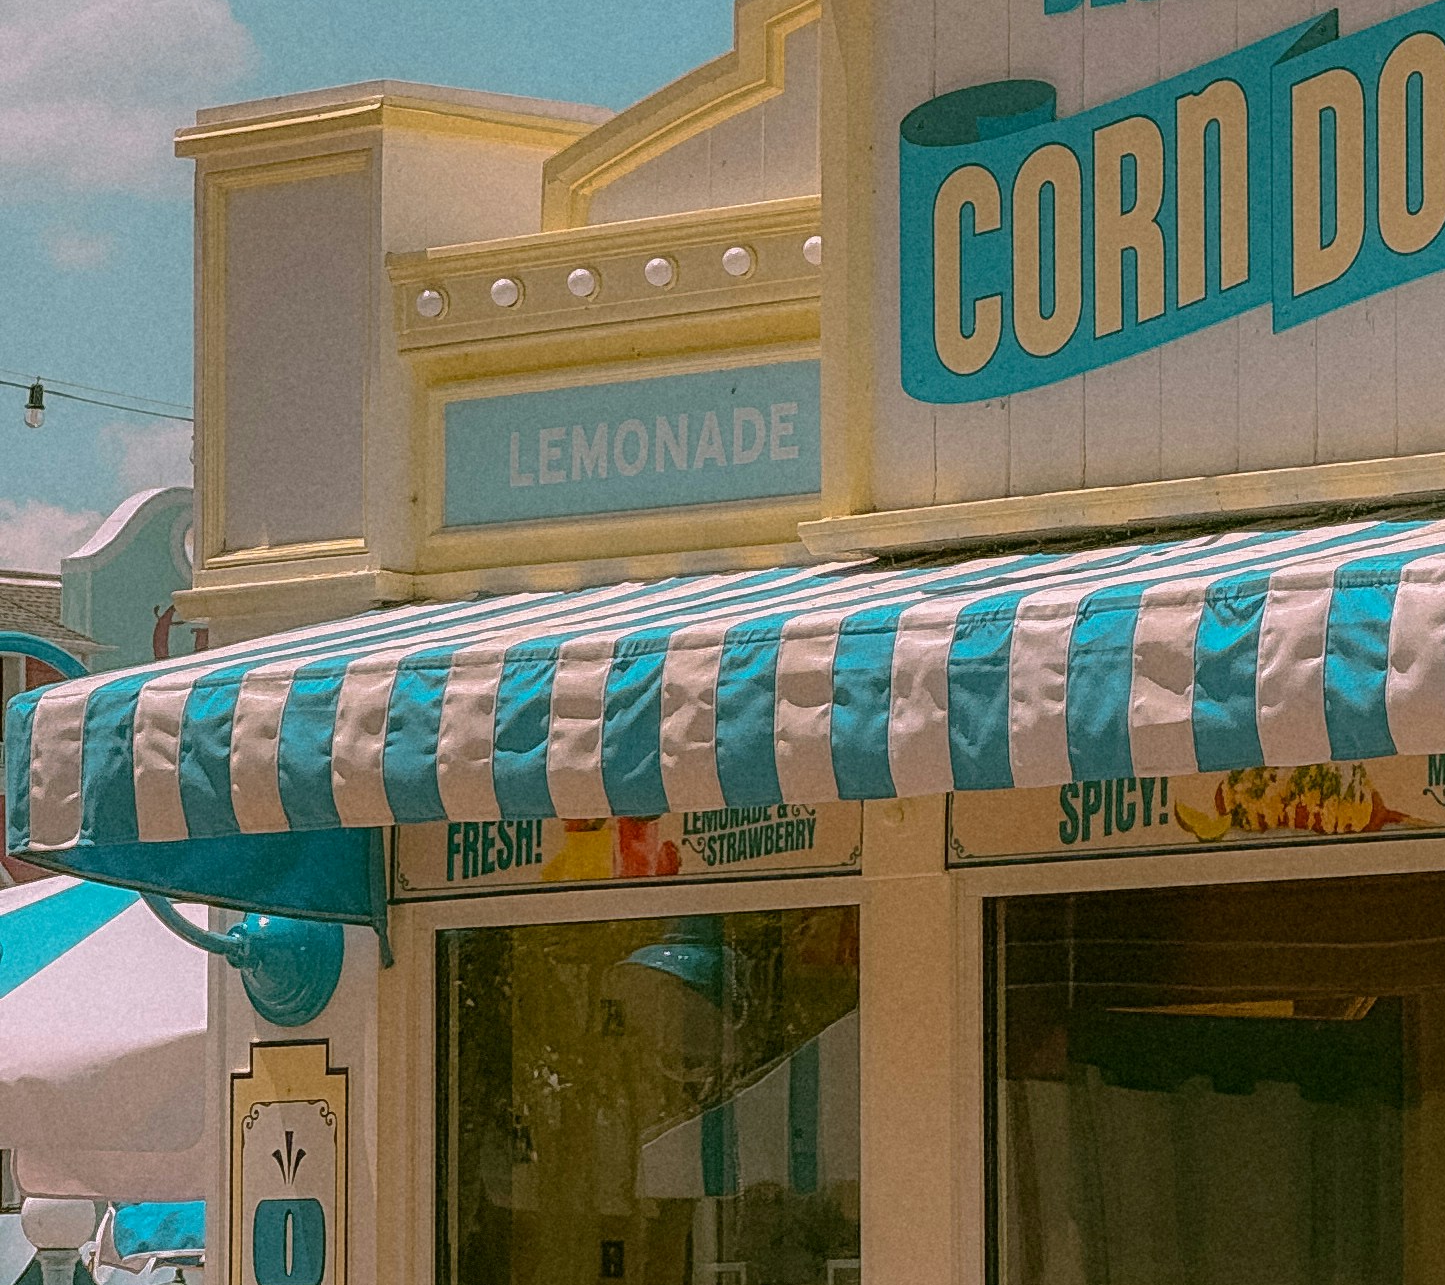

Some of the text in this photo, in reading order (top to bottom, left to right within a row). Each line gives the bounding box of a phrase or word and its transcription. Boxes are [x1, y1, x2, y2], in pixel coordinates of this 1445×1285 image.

[509, 402, 799, 487] LEMONADE
[707, 817, 816, 866] STRAWBERRY
[1059, 776, 1168, 844] SPICY!
[447, 819, 542, 881] FRESH!
